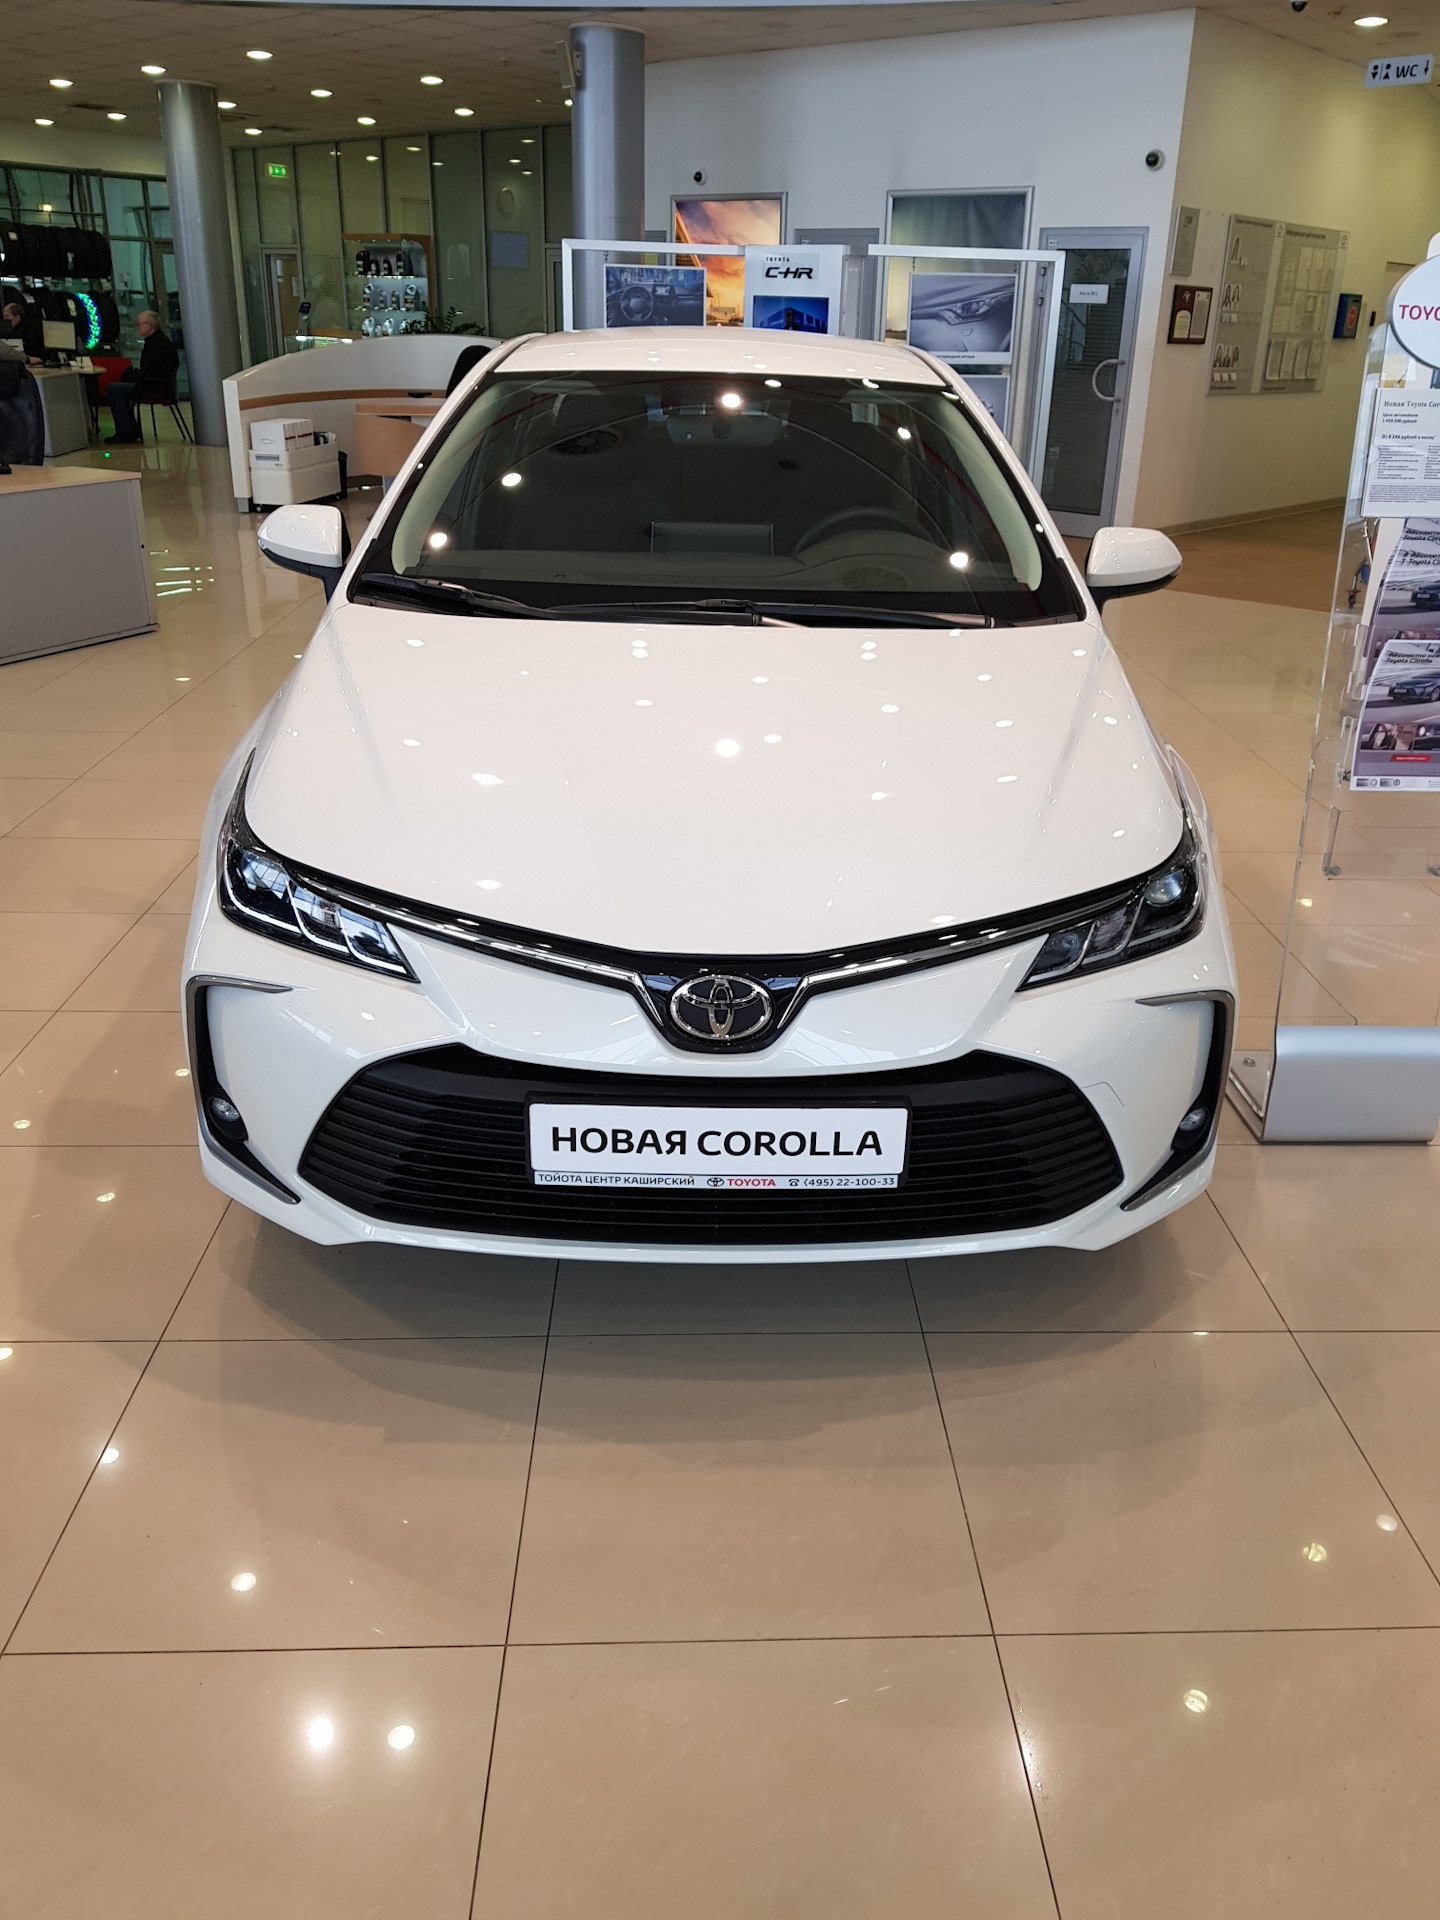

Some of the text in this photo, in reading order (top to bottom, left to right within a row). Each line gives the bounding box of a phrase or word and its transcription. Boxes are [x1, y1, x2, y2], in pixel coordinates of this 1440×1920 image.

[1396, 64, 1418, 78] WC
[765, 266, 814, 279] C-HR
[1407, 400, 1427, 408] Toyota
[1409, 558, 1431, 566] Toyota
[552, 1126, 883, 1156] НОВАЯ COROLLA
[538, 1172, 895, 1188] ТОЙОТА ЦЕНТР КАШИРСКИЙ TOYOTA (495) 22-100-33
